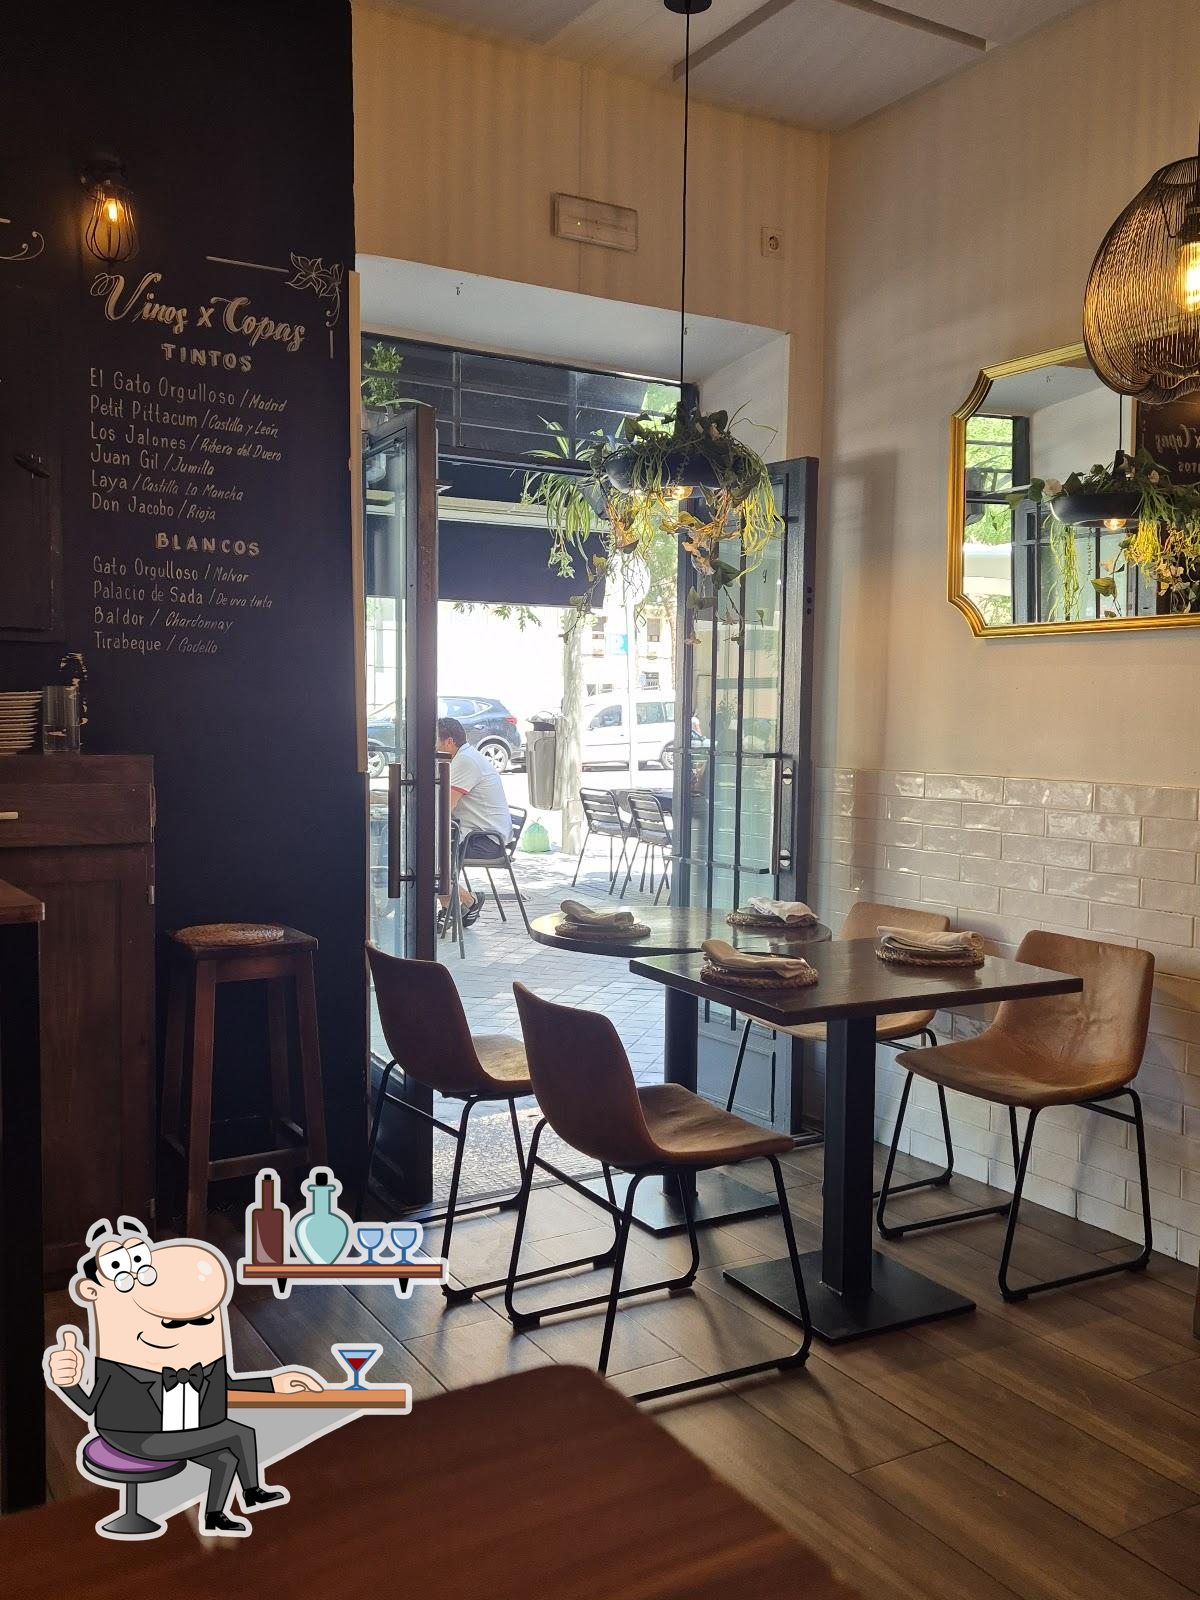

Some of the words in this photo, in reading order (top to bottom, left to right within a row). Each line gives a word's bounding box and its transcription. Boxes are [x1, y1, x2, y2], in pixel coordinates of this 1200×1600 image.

[90, 271, 188, 334] Vinos
[210, 297, 306, 352] Copas
[161, 343, 254, 373] TINTOS
[90, 367, 103, 388] El
[113, 371, 151, 394] Gato
[158, 376, 235, 405] Orgulloso
[90, 394, 124, 419] Petit
[132, 400, 198, 428] Pittacum
[90, 420, 116, 442] Los
[125, 424, 186, 450] Jalones
[236, 443, 253, 457] del
[252, 444, 282, 462] Duero
[90, 443, 130, 466] Juan
[139, 449, 159, 470] Gil
[91, 469, 128, 493] Laya
[201, 484, 244, 502] Mancha
[91, 492, 119, 513] Don
[127, 495, 174, 517] Jacobo
[186, 504, 217, 523] Rioja
[154, 531, 261, 557] BLANCOS
[93, 555, 127, 576] Gato
[134, 557, 199, 581] Orgulloso
[93, 579, 145, 601] Palacio
[151, 584, 165, 602] de
[169, 586, 203, 605] Sada
[93, 606, 145, 626] Baldor
[165, 610, 234, 634] Chardonnay
[93, 630, 162, 656] Tirabeque
